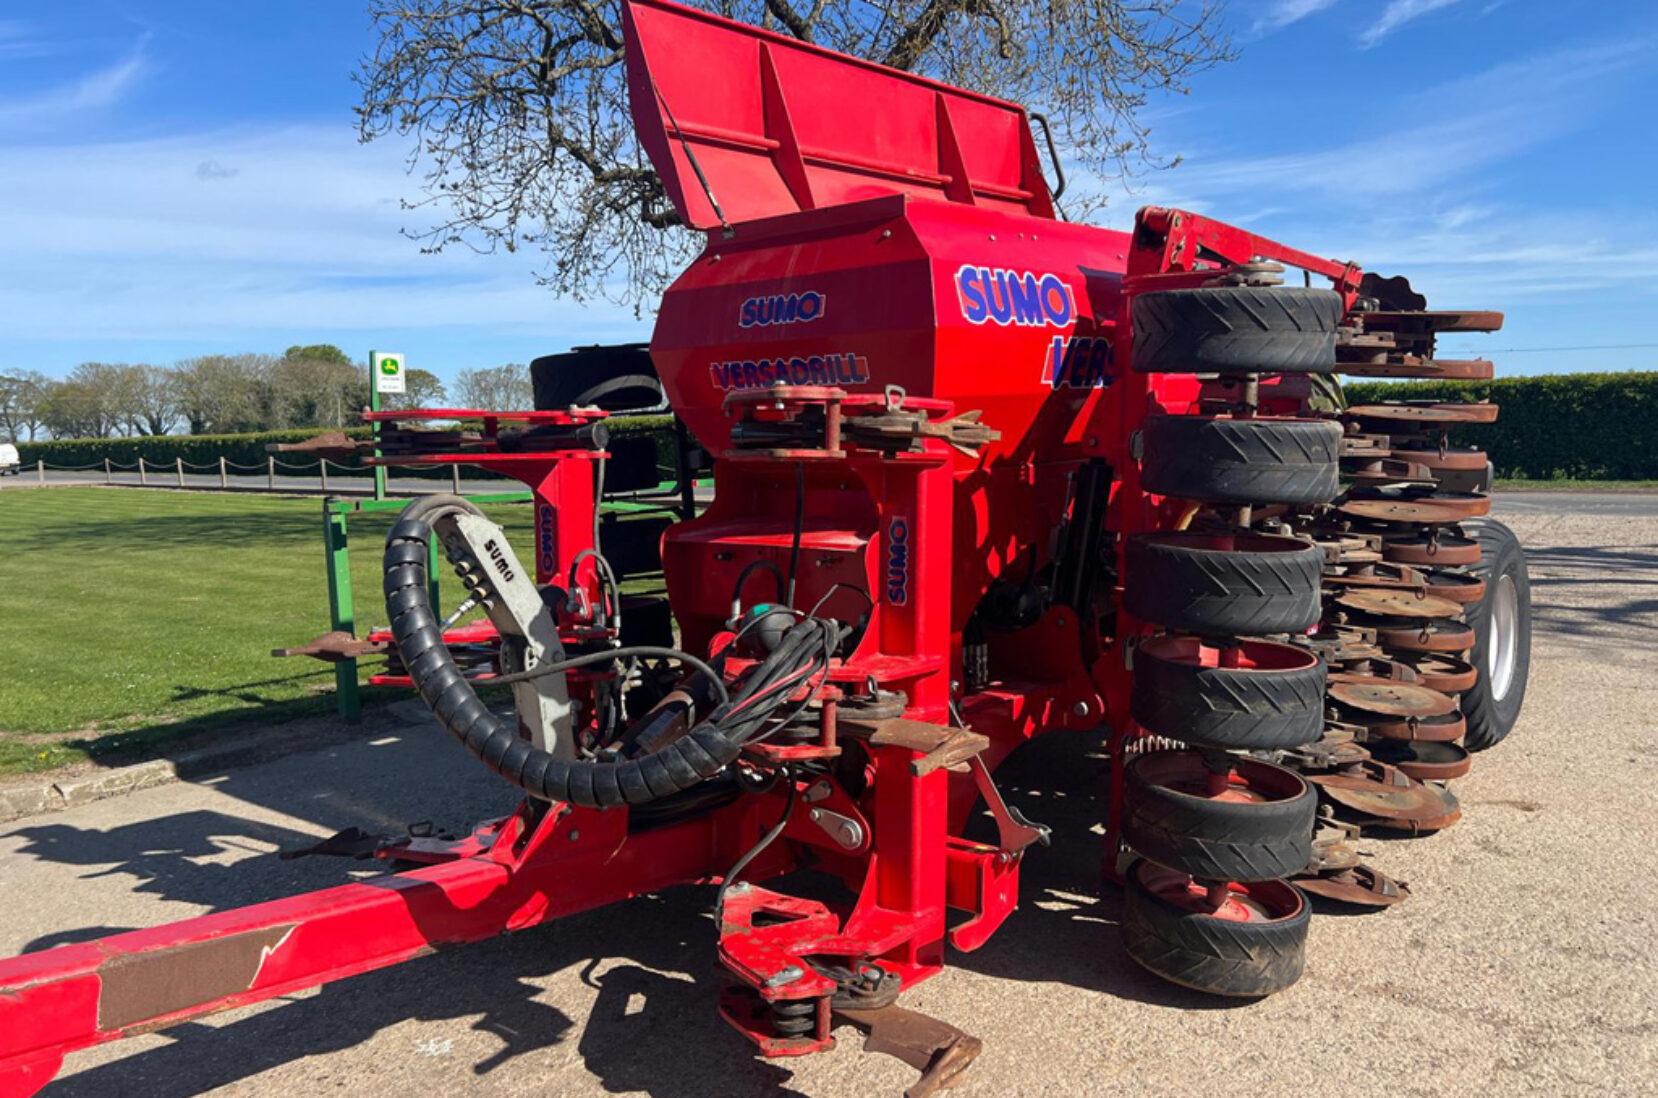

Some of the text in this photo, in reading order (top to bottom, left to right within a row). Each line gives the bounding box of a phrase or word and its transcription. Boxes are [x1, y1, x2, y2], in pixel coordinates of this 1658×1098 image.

[740, 291, 823, 327] SUMO
[957, 265, 1074, 327] SUMO
[712, 354, 867, 390] VERSADRILL
[539, 504, 553, 573] SUMO
[888, 518, 908, 606] SUMO
